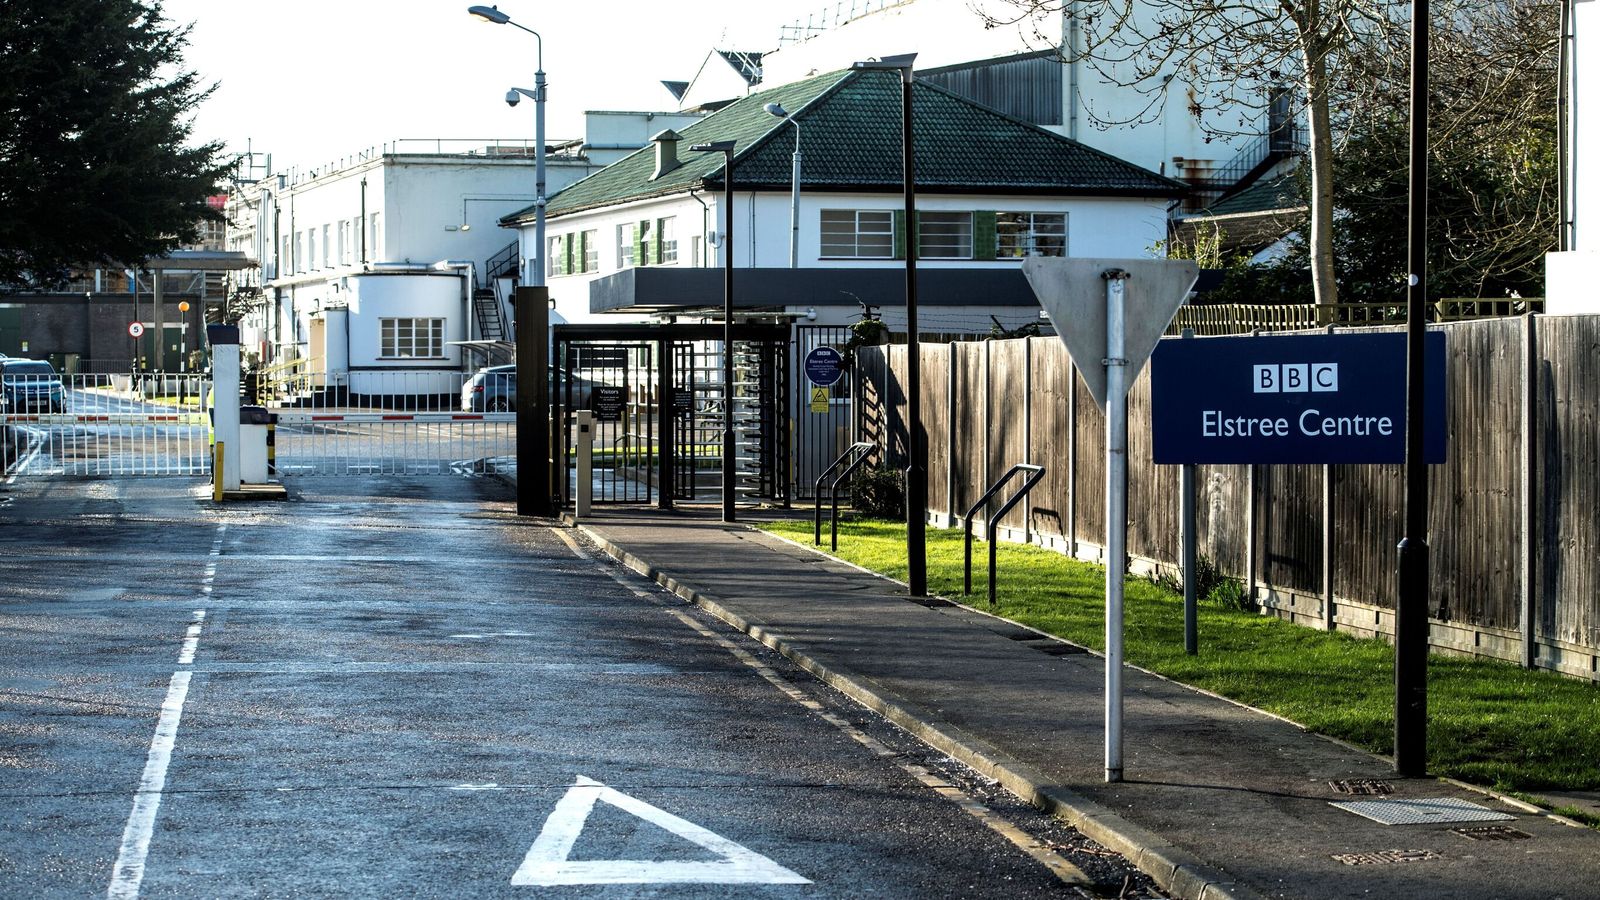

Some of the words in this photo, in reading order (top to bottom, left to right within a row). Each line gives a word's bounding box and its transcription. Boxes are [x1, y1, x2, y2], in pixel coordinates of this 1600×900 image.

[1256, 365, 1335, 391] BBC
[1202, 410, 1289, 437] Elstree
[1299, 409, 1393, 436] Centre
